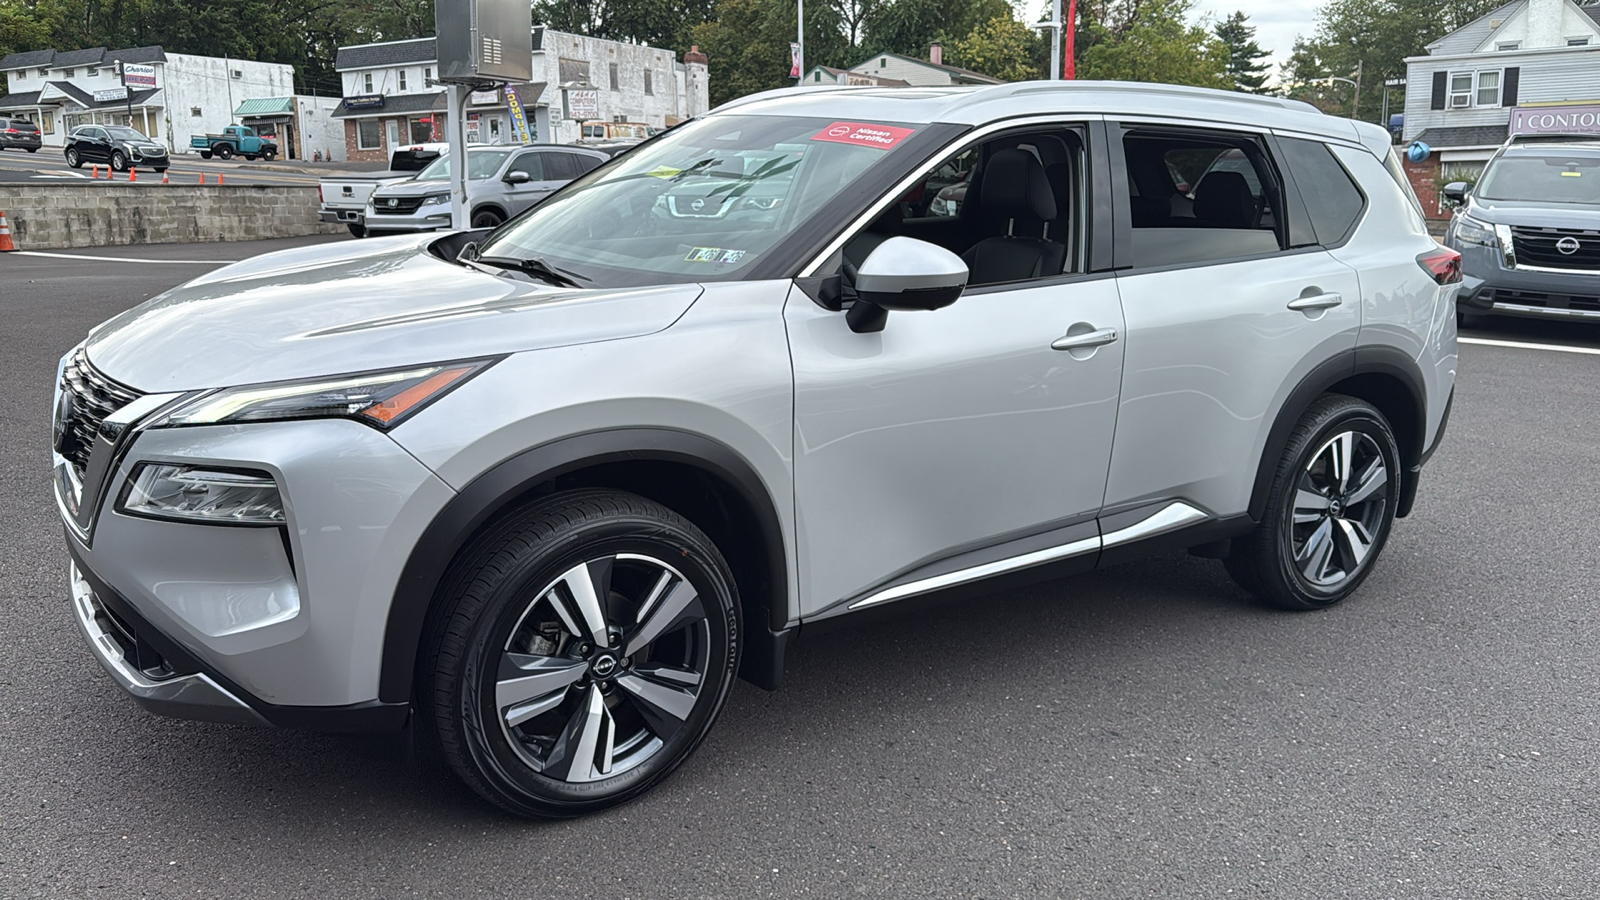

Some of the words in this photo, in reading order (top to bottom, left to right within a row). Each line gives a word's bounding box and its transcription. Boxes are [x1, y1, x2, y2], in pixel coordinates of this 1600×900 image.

[125, 65, 154, 73] Charles
[857, 128, 890, 137] Nissan
[849, 133, 894, 144] Certified
